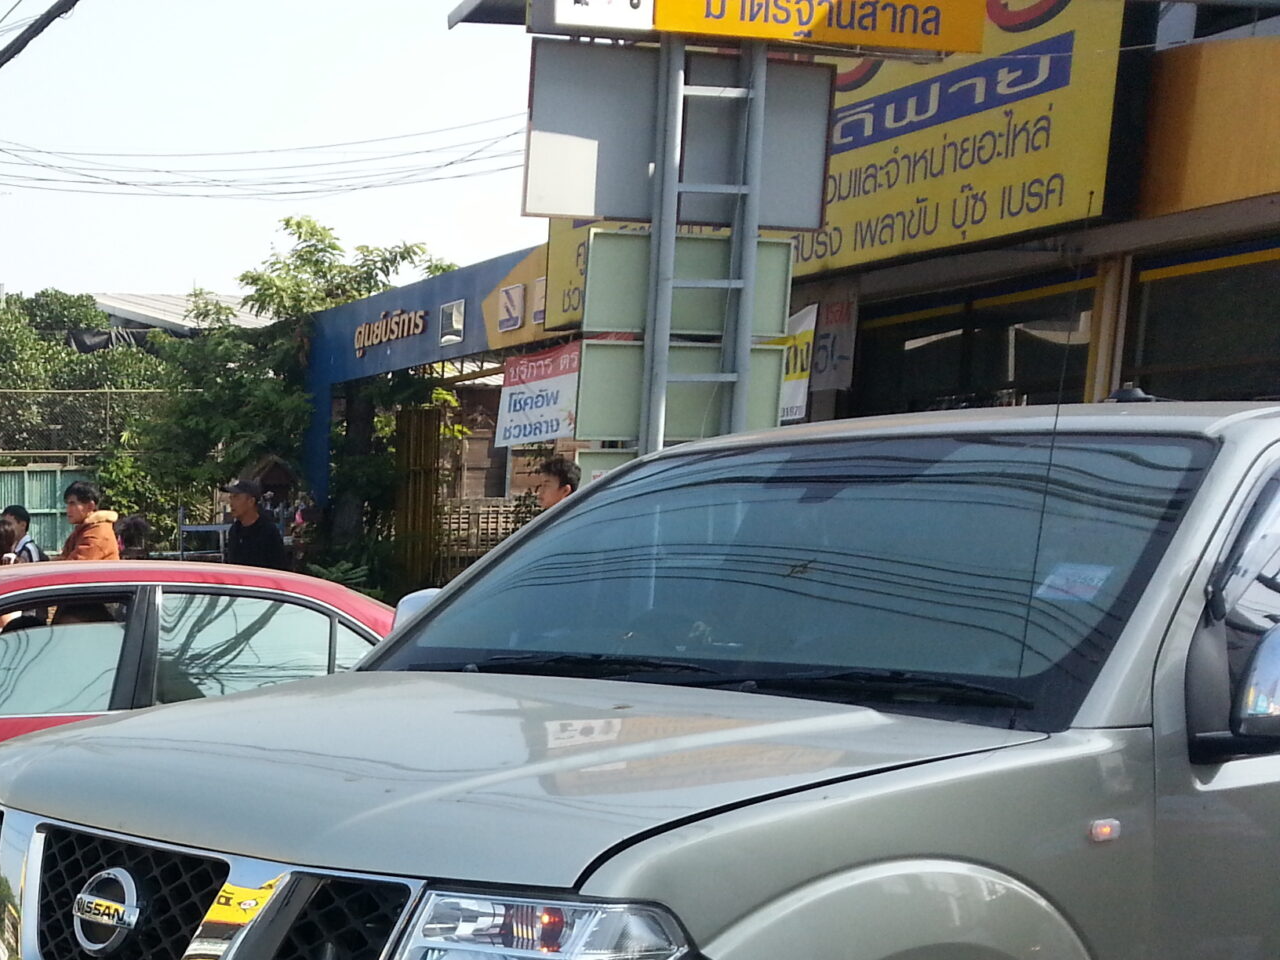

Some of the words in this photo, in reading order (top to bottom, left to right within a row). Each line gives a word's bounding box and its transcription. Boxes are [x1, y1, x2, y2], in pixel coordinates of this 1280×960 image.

[833, 54, 1051, 146] ดิฟาย
[1000, 172, 1065, 220] เบรค
[75, 897, 126, 922] NISSAN
